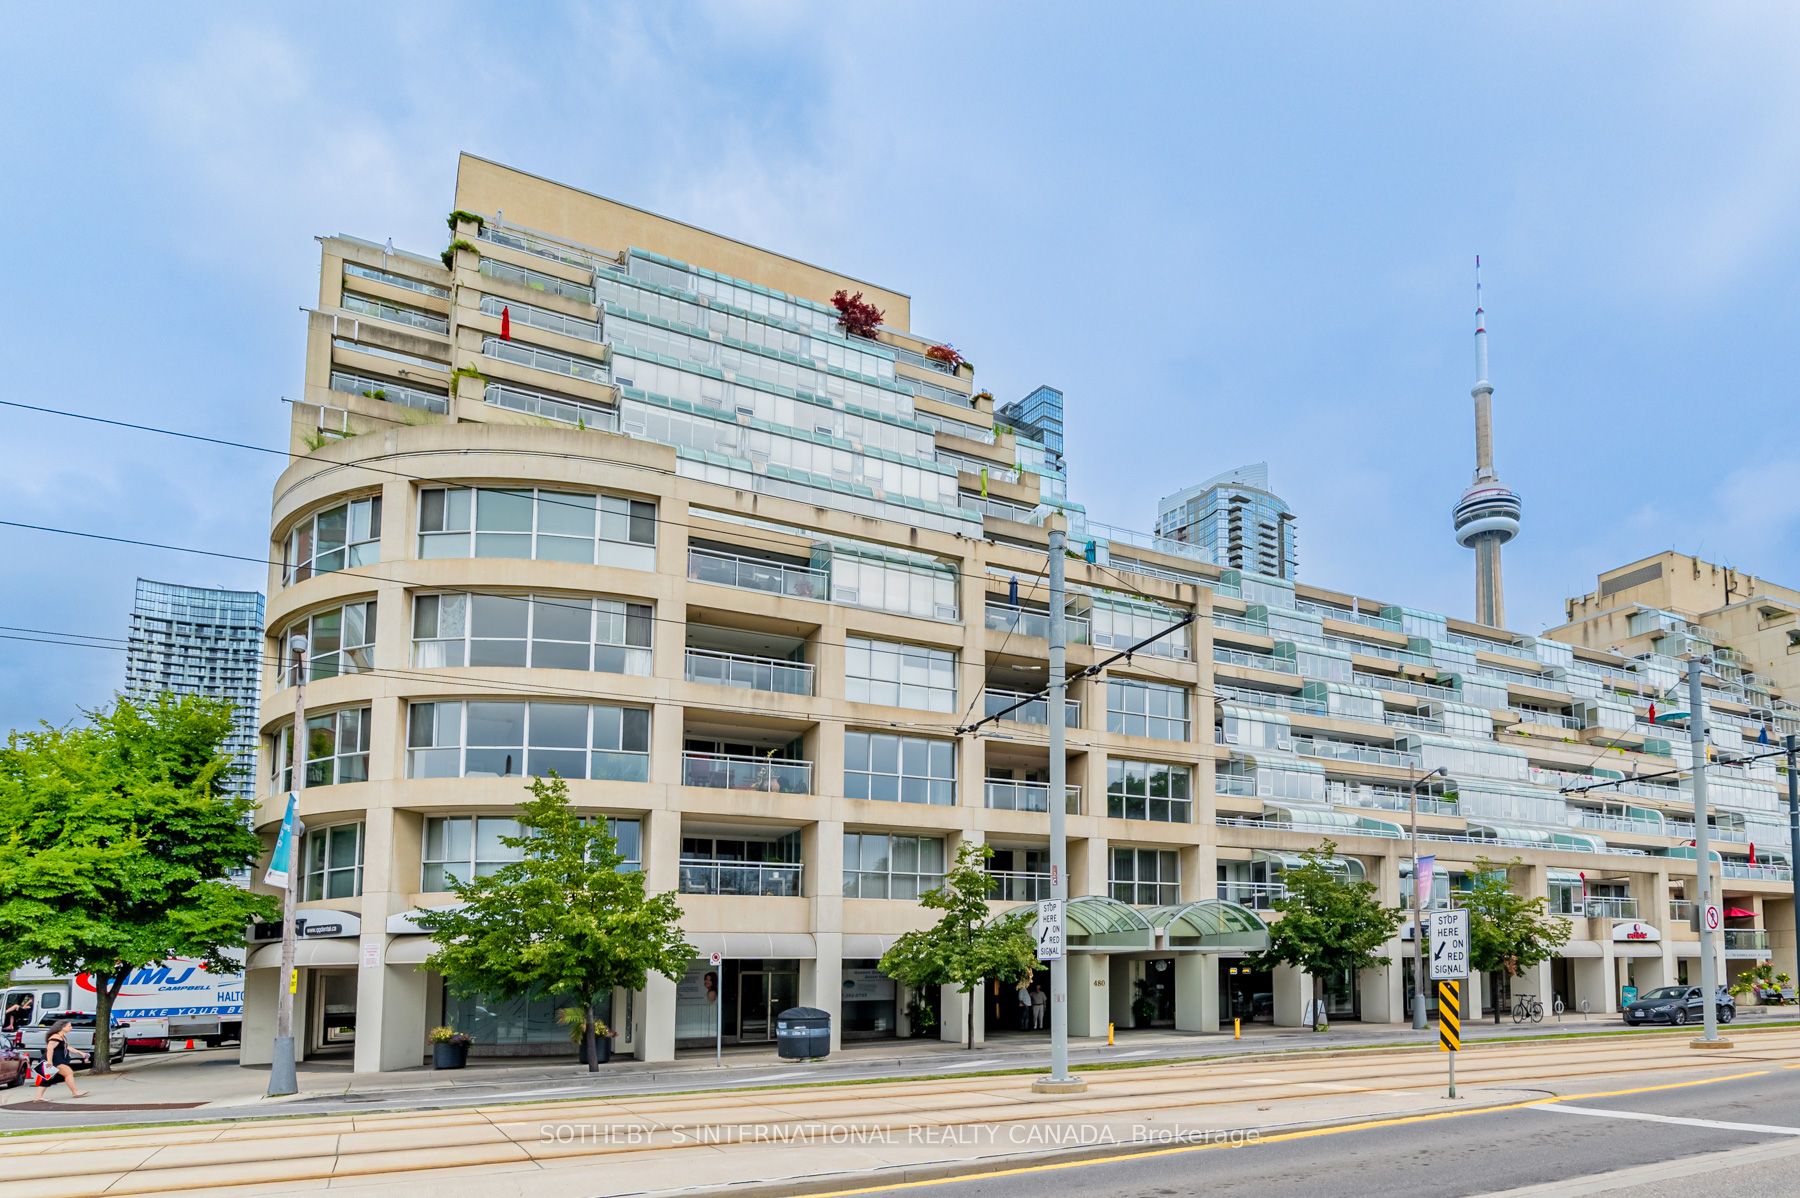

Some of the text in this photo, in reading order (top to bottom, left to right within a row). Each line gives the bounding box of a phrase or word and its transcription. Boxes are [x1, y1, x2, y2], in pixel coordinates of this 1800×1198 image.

[1043, 903, 1057, 912] STOP
[1043, 914, 1057, 923] HERE
[1438, 915, 1458, 925] STOP
[1052, 925, 1060, 933] ON
[1437, 927, 1459, 937] HERE
[1049, 936, 1060, 944] RED
[1452, 939, 1464, 949] ON
[1040, 947, 1059, 956] SIGNAL
[1447, 952, 1464, 961] RED
[1434, 964, 1464, 974] SIGNAL
[1093, 979, 1105, 987] 480
[124, 1009, 168, 1018] MAKE
[178, 1007, 218, 1016] YOUR
